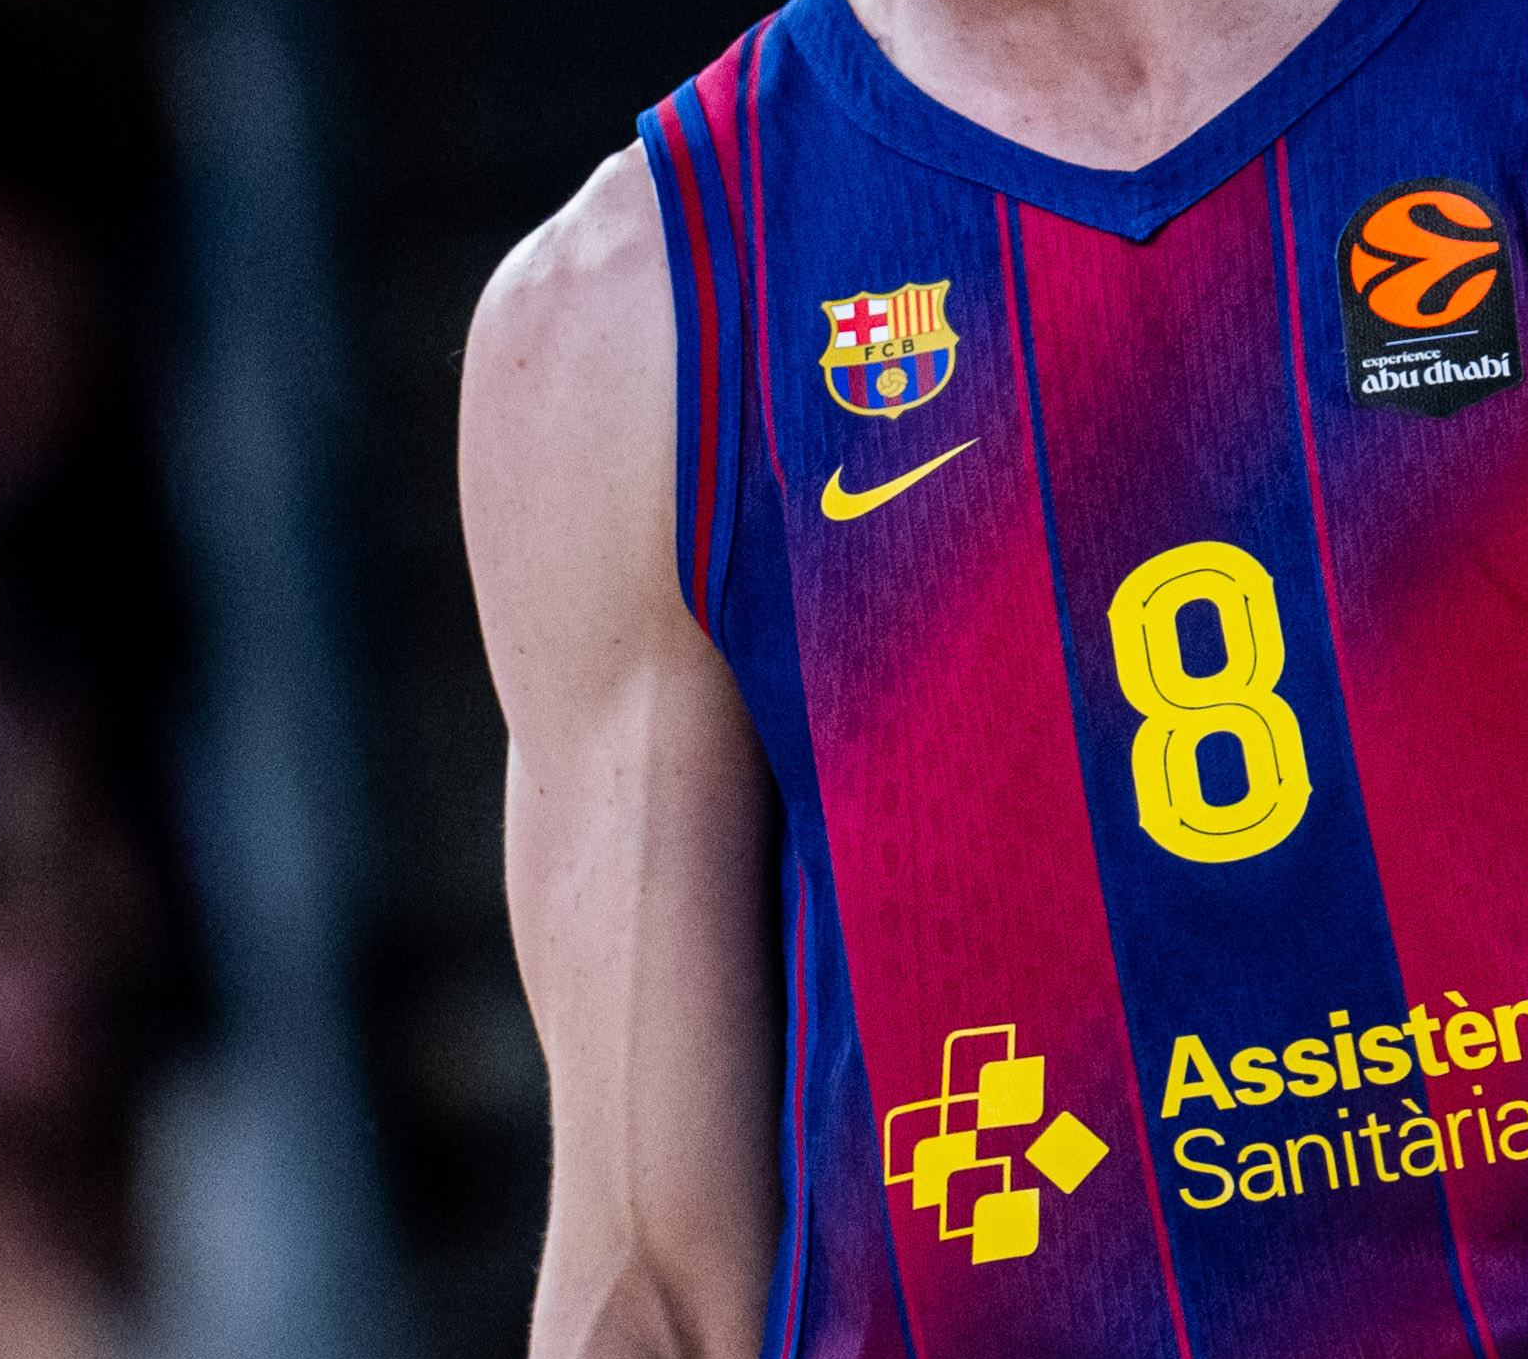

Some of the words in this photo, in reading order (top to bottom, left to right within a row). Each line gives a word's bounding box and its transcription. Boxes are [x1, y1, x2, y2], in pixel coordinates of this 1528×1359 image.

[1362, 349, 1442, 368] experience
[1361, 367, 1420, 394] abu
[1107, 540, 1312, 864] 8
